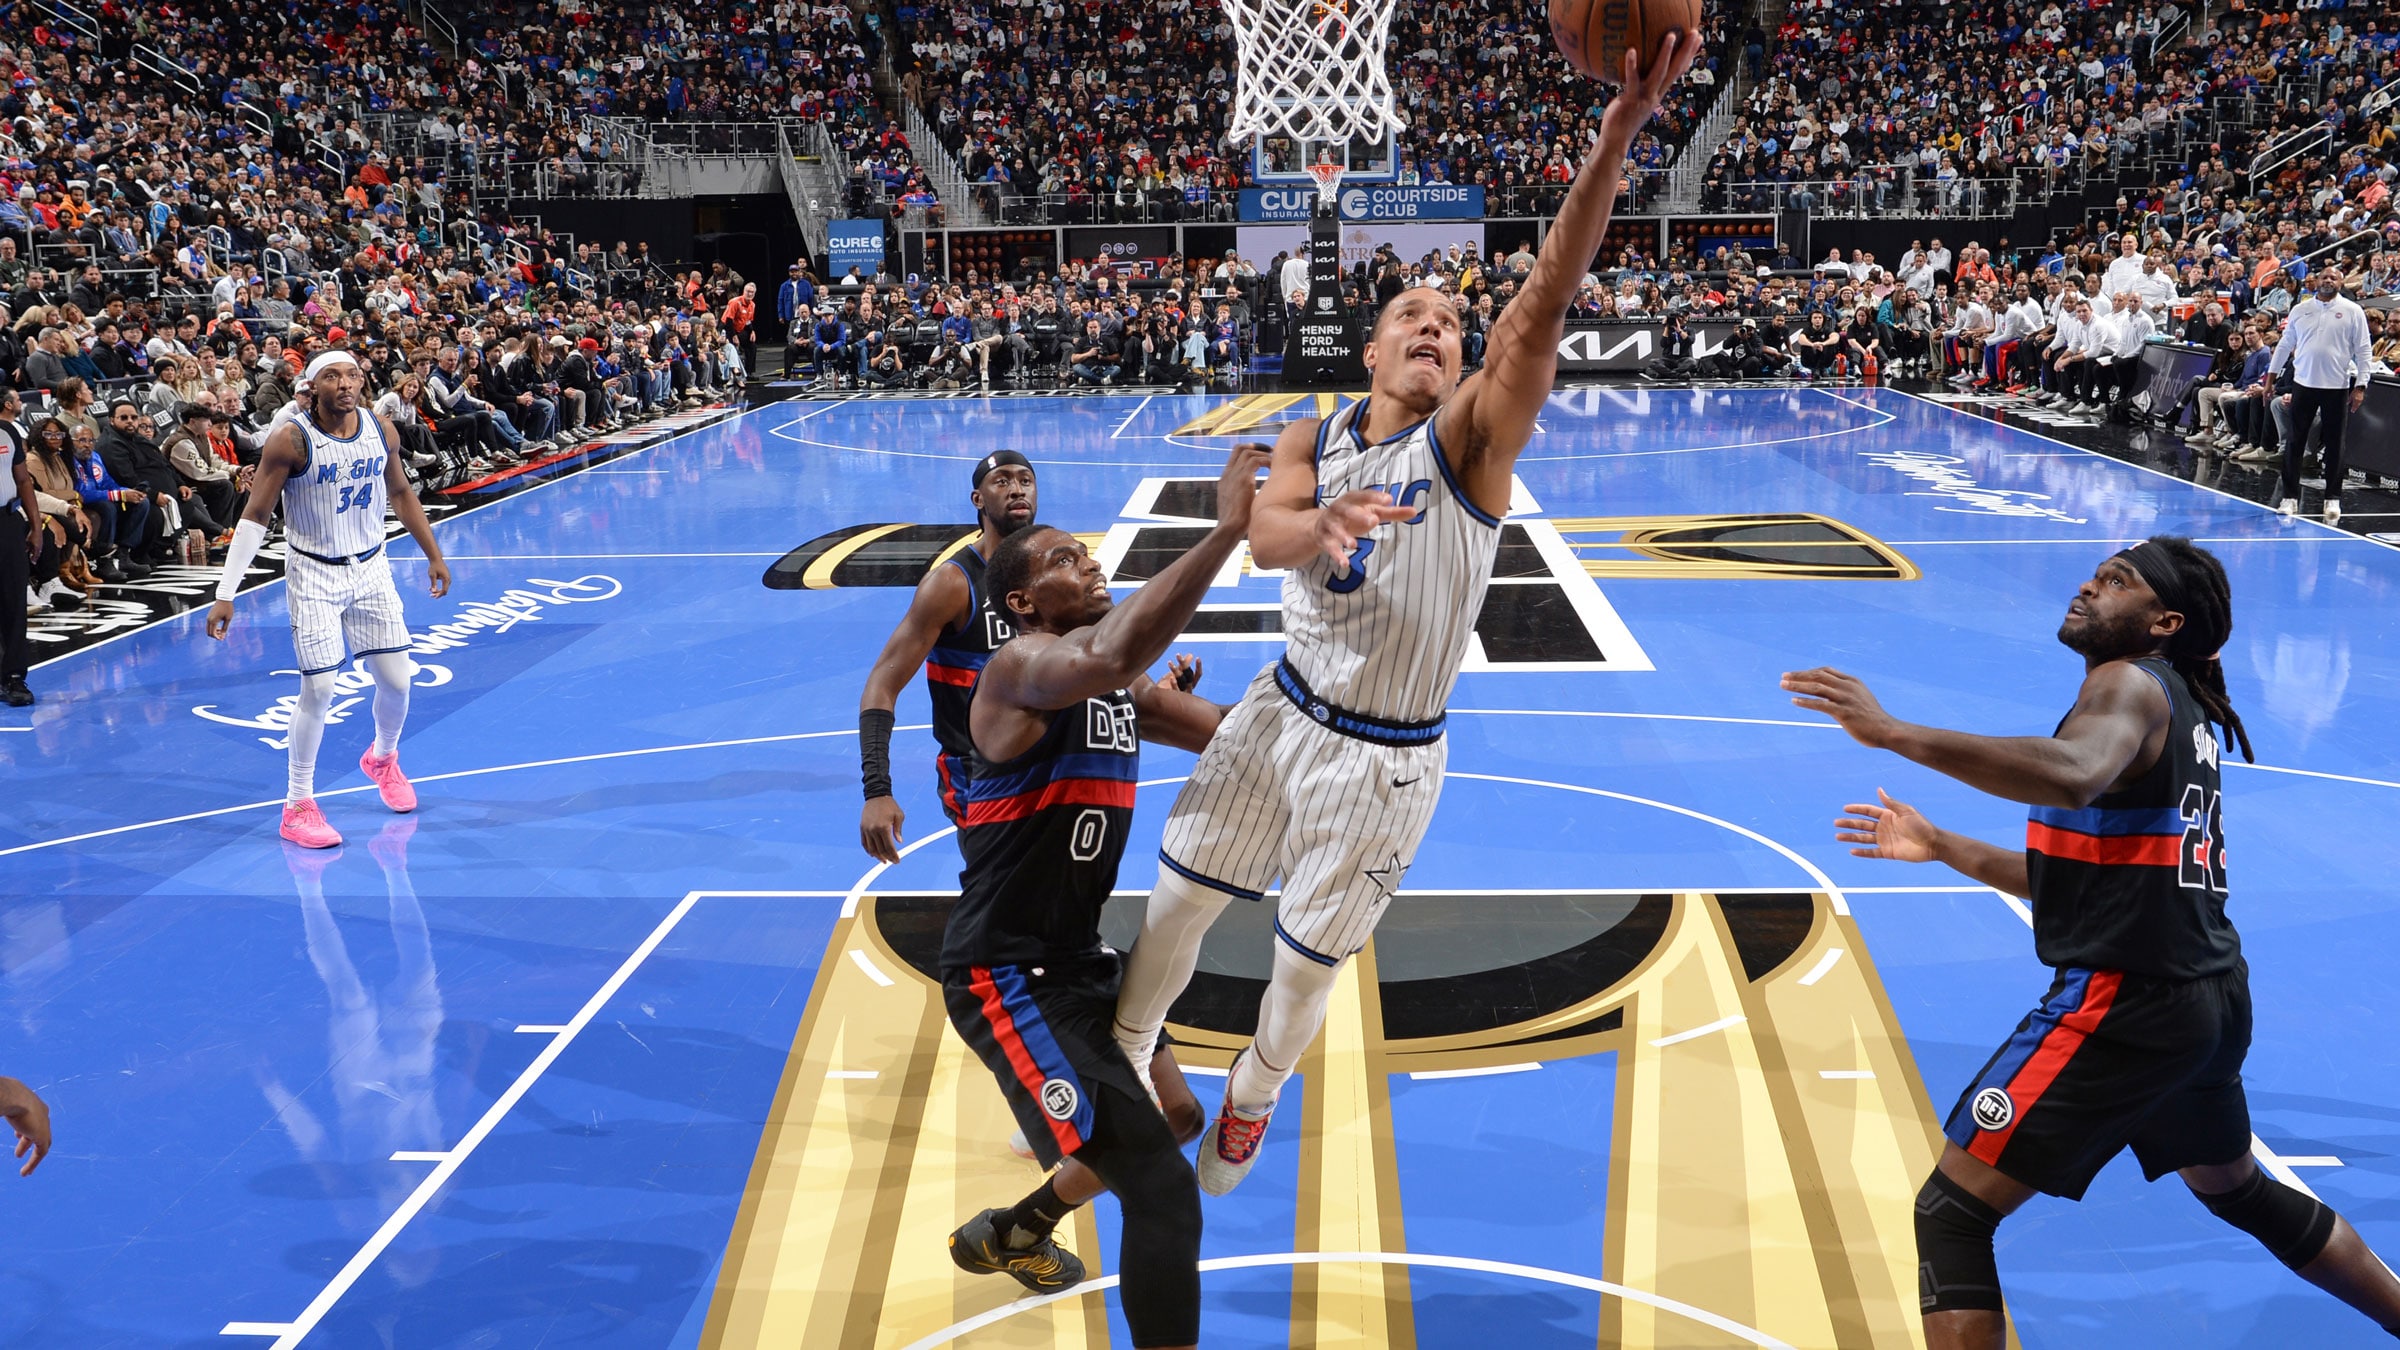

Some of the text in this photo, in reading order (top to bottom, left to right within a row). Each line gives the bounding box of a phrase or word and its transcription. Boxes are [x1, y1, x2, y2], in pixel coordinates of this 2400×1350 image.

[1602, 0, 1630, 79] Wilso
[1260, 191, 1318, 210] CUR
[1372, 188, 1468, 203] COURTSIDE
[1261, 210, 1312, 219] INSURANC
[1372, 203, 1418, 217] CLUB
[829, 237, 870, 248] CURE
[1300, 325, 1343, 335] HENRY
[1302, 336, 1334, 346] FORD
[1302, 347, 1351, 357] HEALTH
[336, 483, 373, 514] 34
[1325, 537, 1376, 594] 3
[1087, 698, 1137, 752] DE
[1070, 809, 1107, 861] 0
[1047, 1088, 1071, 1111] DET
[1979, 1096, 2007, 1121] DET
